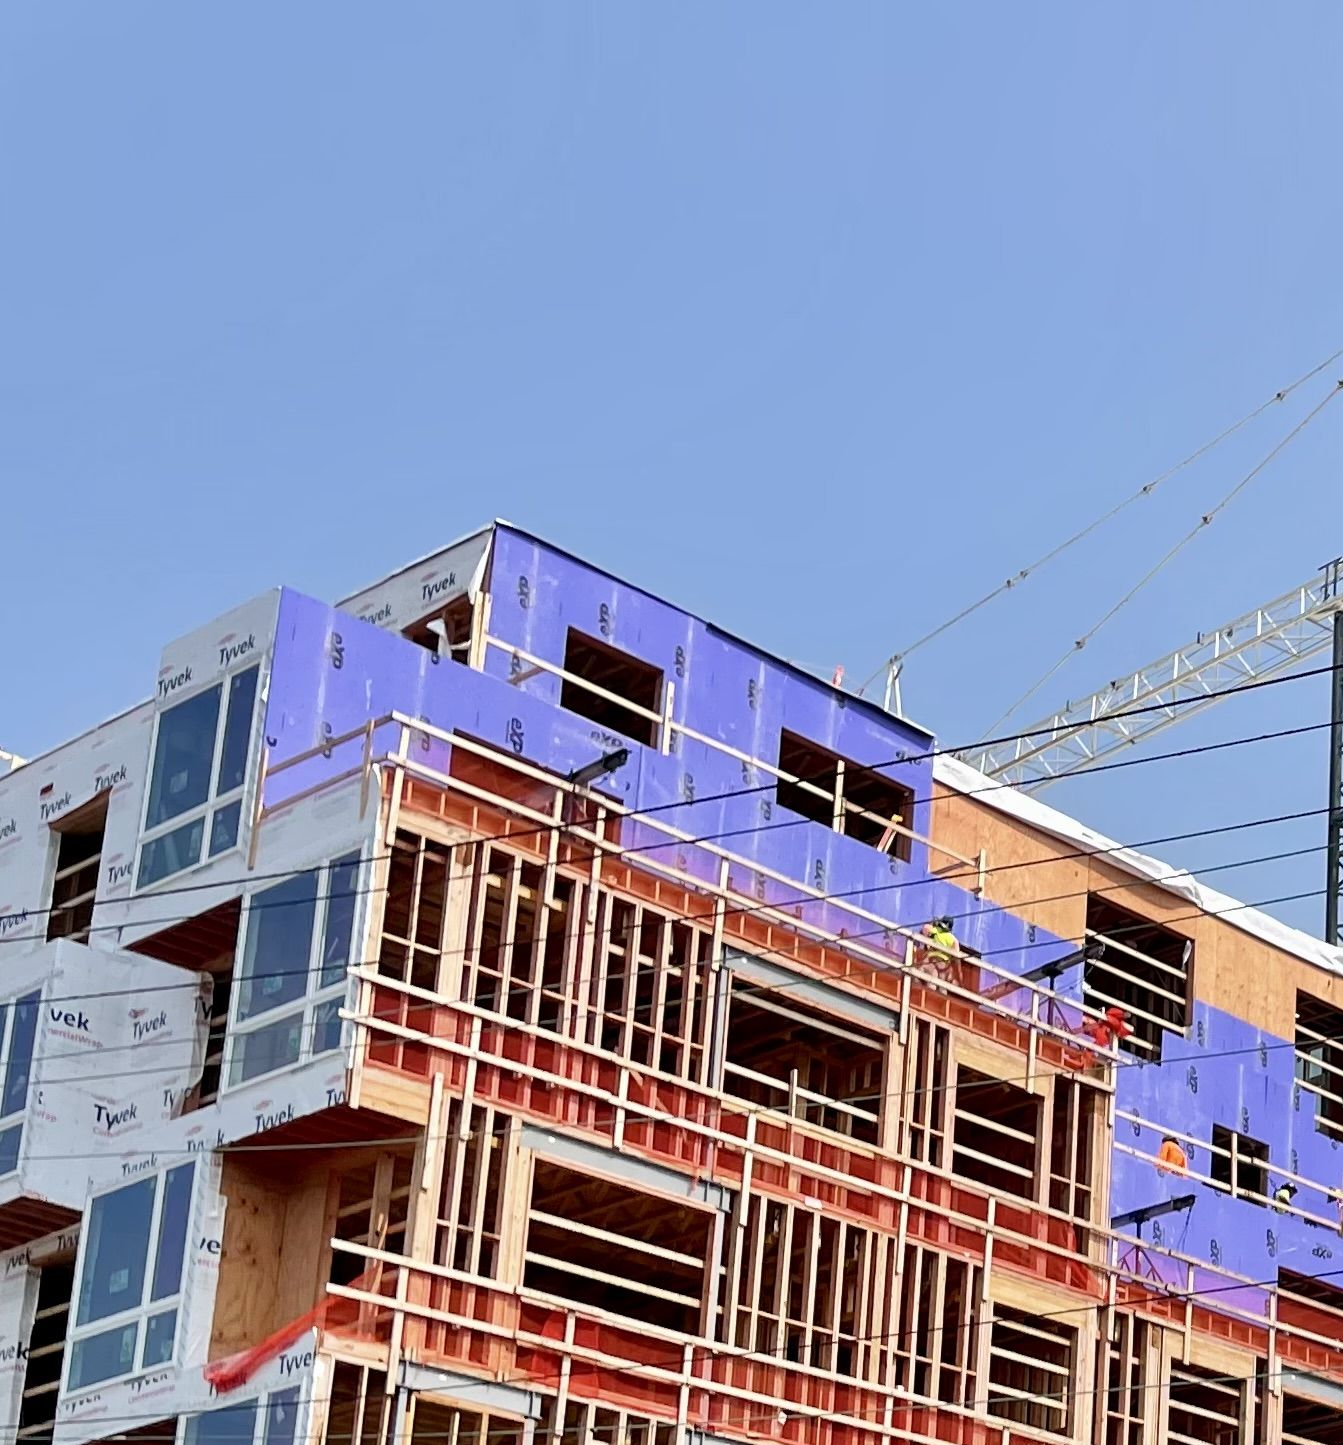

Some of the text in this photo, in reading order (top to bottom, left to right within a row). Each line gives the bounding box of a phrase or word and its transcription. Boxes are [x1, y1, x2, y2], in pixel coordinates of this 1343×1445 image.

[422, 572, 456, 600] Tyvek
[220, 634, 255, 665] Tyvek
[158, 666, 192, 697] Tyvek
[95, 764, 127, 789] Tyvek
[40, 793, 71, 819] Tyvek
[51, 1009, 89, 1032] vek
[134, 1011, 167, 1039] Tyvek
